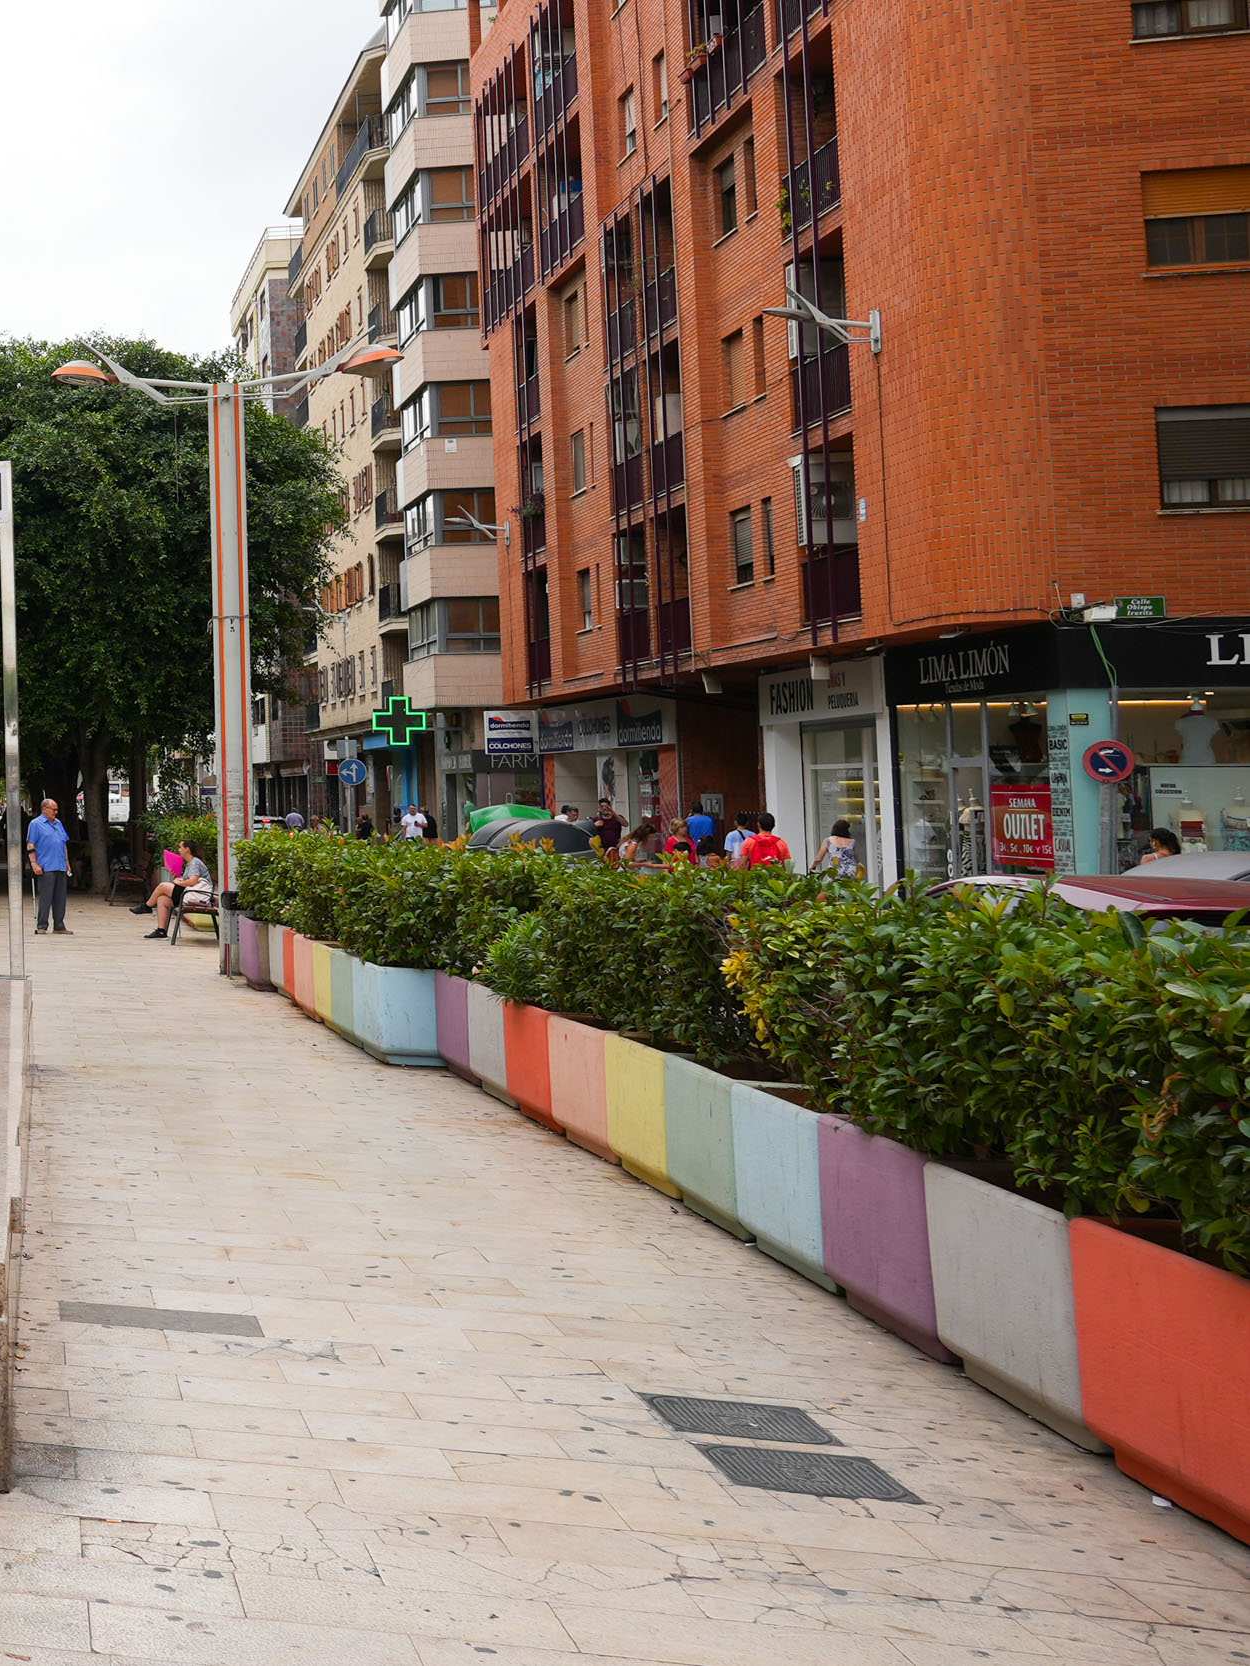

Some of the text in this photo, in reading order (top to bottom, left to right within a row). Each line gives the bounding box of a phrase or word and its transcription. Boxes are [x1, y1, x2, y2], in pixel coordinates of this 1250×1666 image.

[918, 640, 1010, 684] LIMA LIMÓN
[770, 678, 814, 715] FASHION
[1048, 739, 1068, 750] BASIC
[1009, 798, 1036, 808] SEMANA
[1003, 813, 1045, 840] OUTLET
